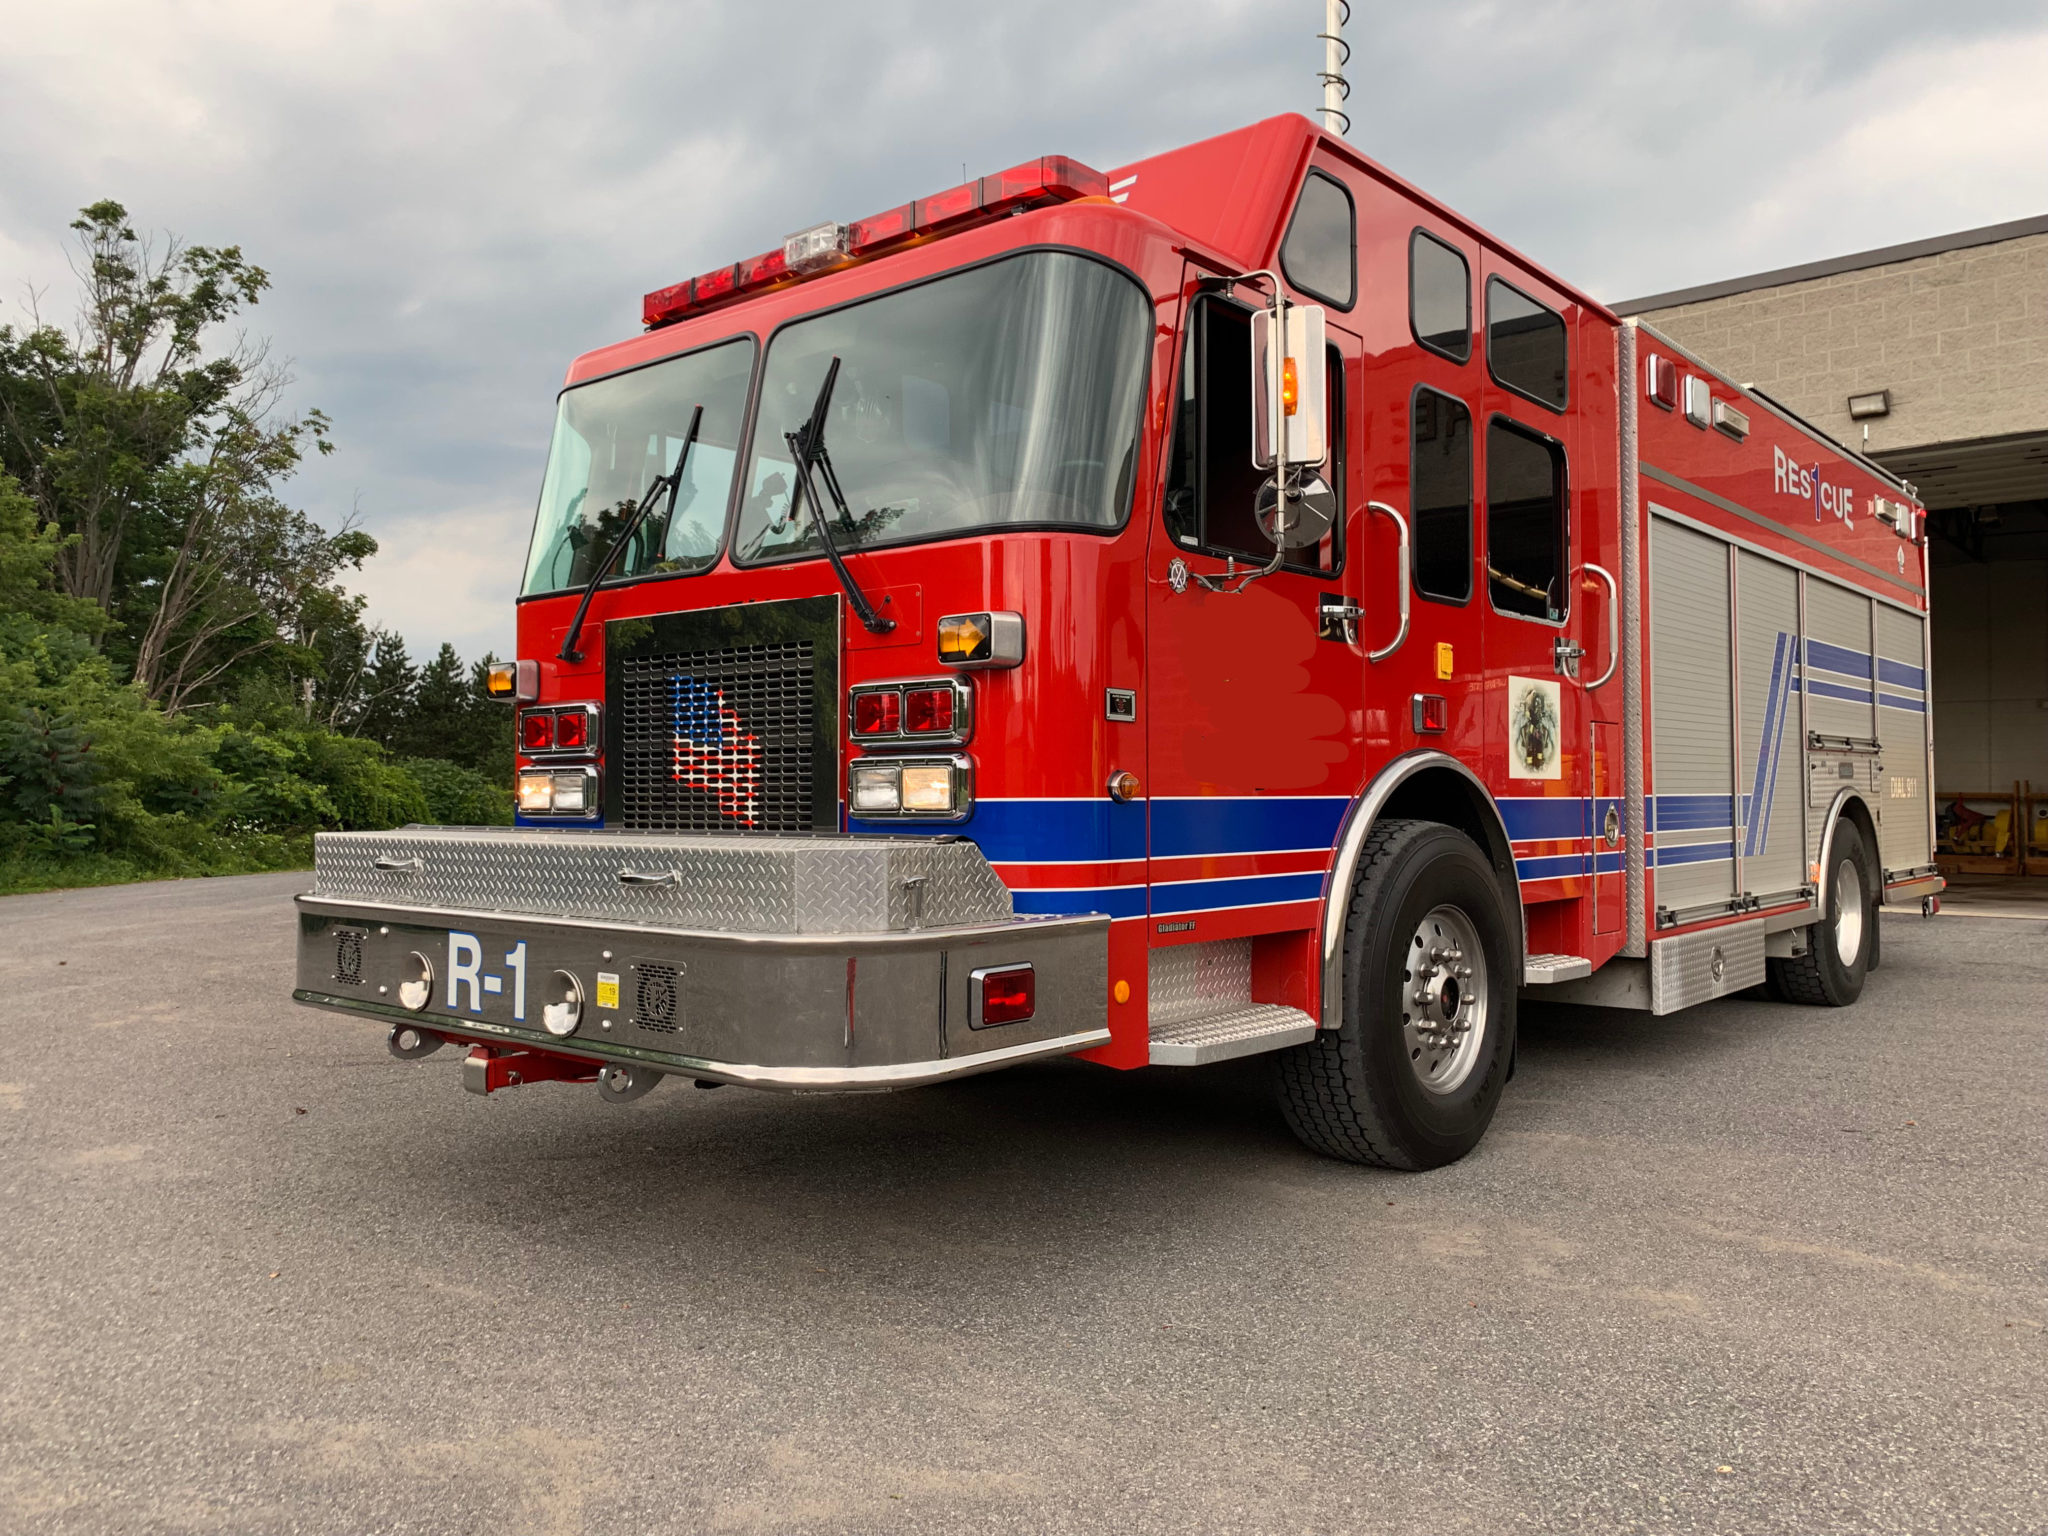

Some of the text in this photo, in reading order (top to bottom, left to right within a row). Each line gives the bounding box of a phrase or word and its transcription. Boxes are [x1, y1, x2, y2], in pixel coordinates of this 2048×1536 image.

[1890, 776, 1917, 798] DIAL 911
[1158, 922, 1188, 933] Gladiator
[446, 929, 528, 1022] R-1
